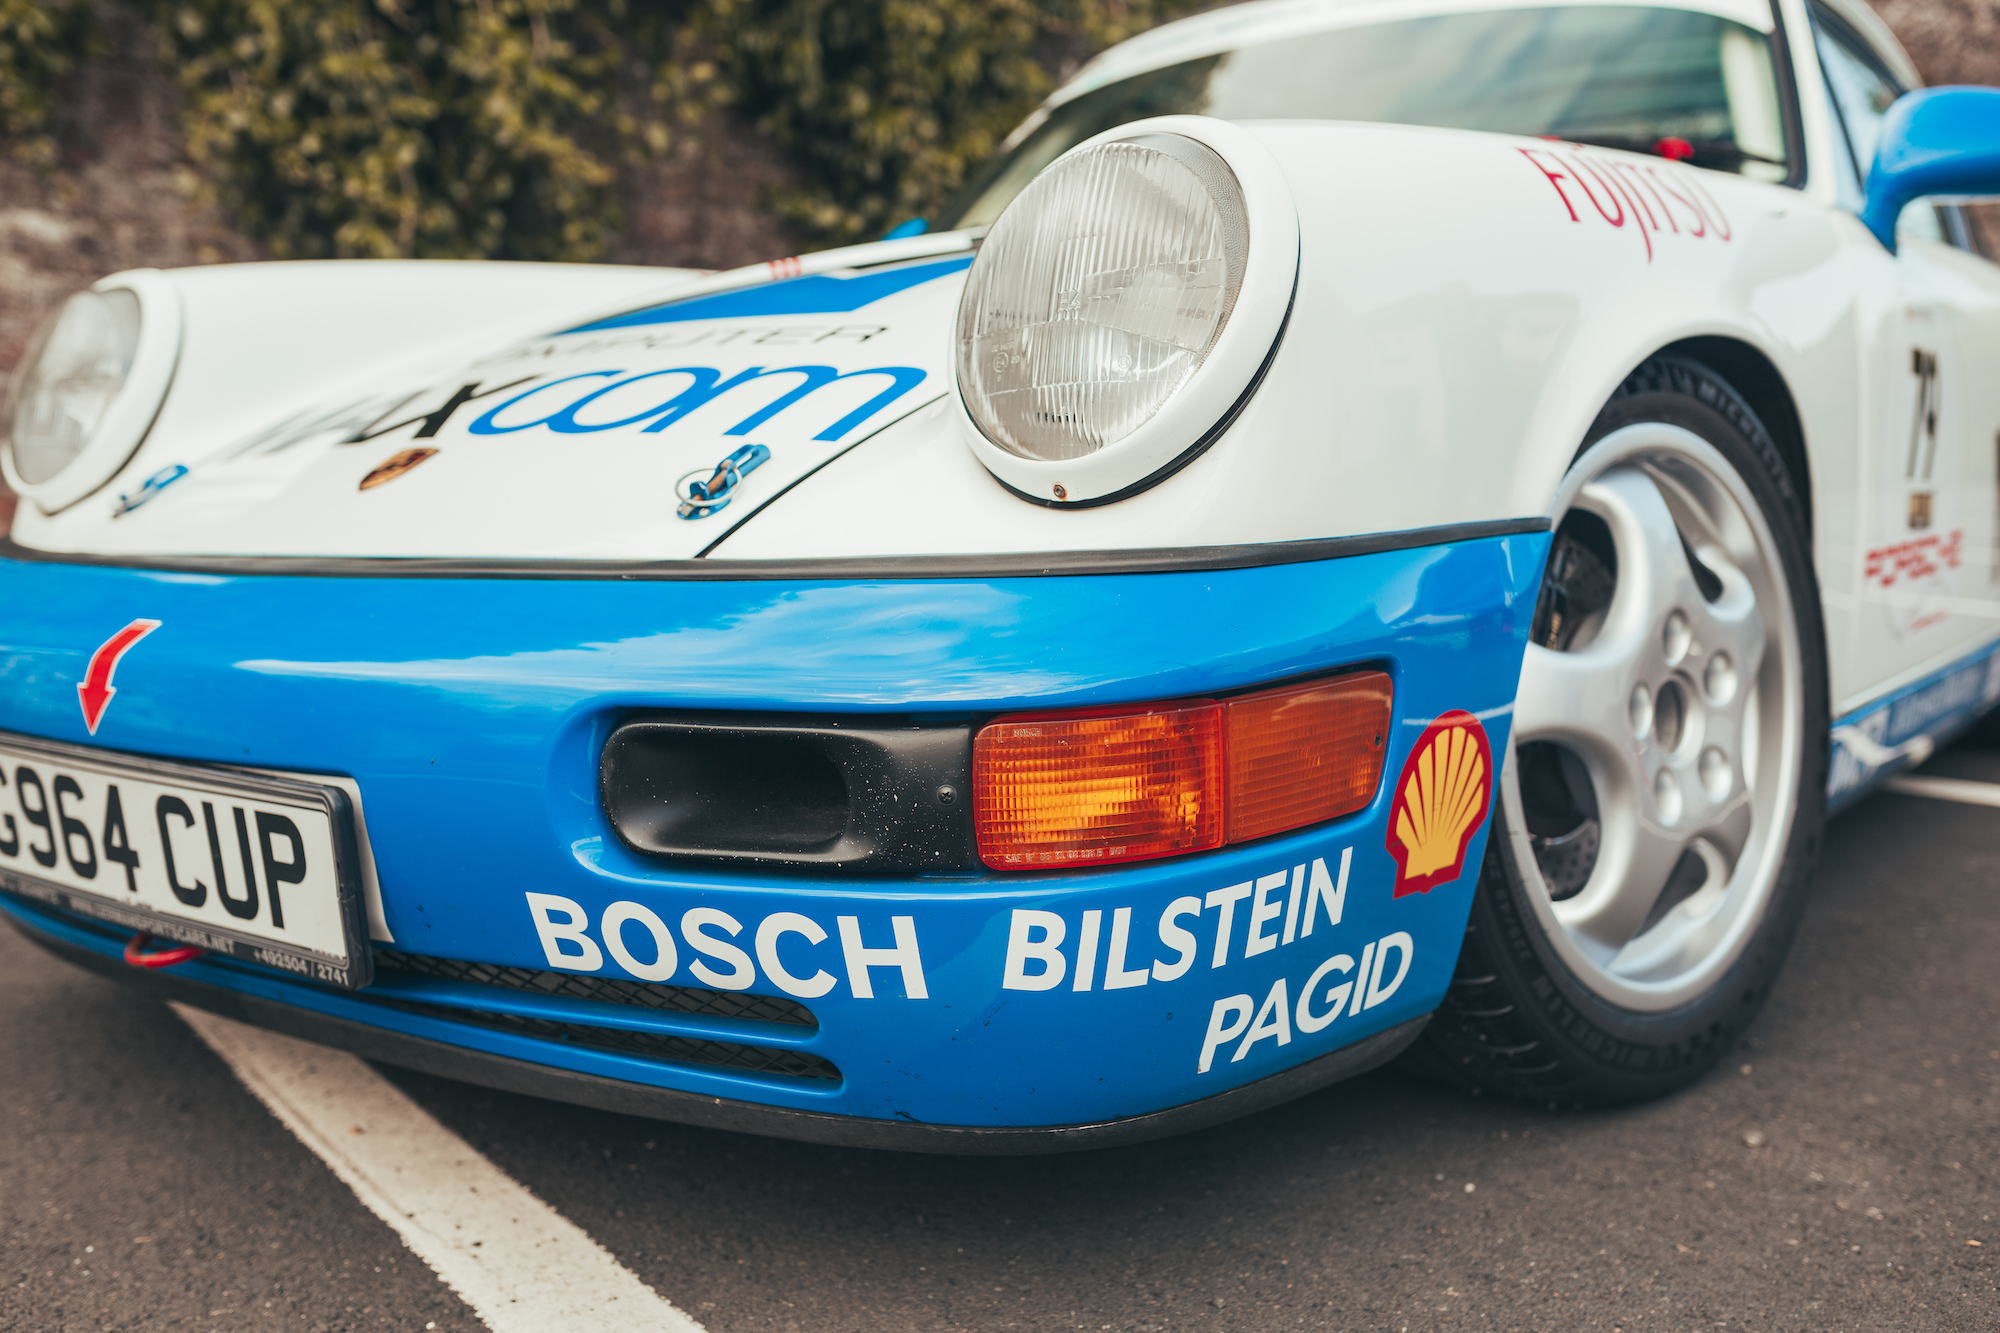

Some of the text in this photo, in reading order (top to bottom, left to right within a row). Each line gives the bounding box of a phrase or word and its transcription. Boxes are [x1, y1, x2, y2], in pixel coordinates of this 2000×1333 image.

[464, 324, 890, 369] OMPUTER
[156, 794, 307, 930] CUP
[1002, 846, 1353, 993] BILSTEIN
[317, 964, 349, 987] 2741
[525, 891, 930, 1000] BOSCH
[1196, 930, 1414, 1075] PAGID
